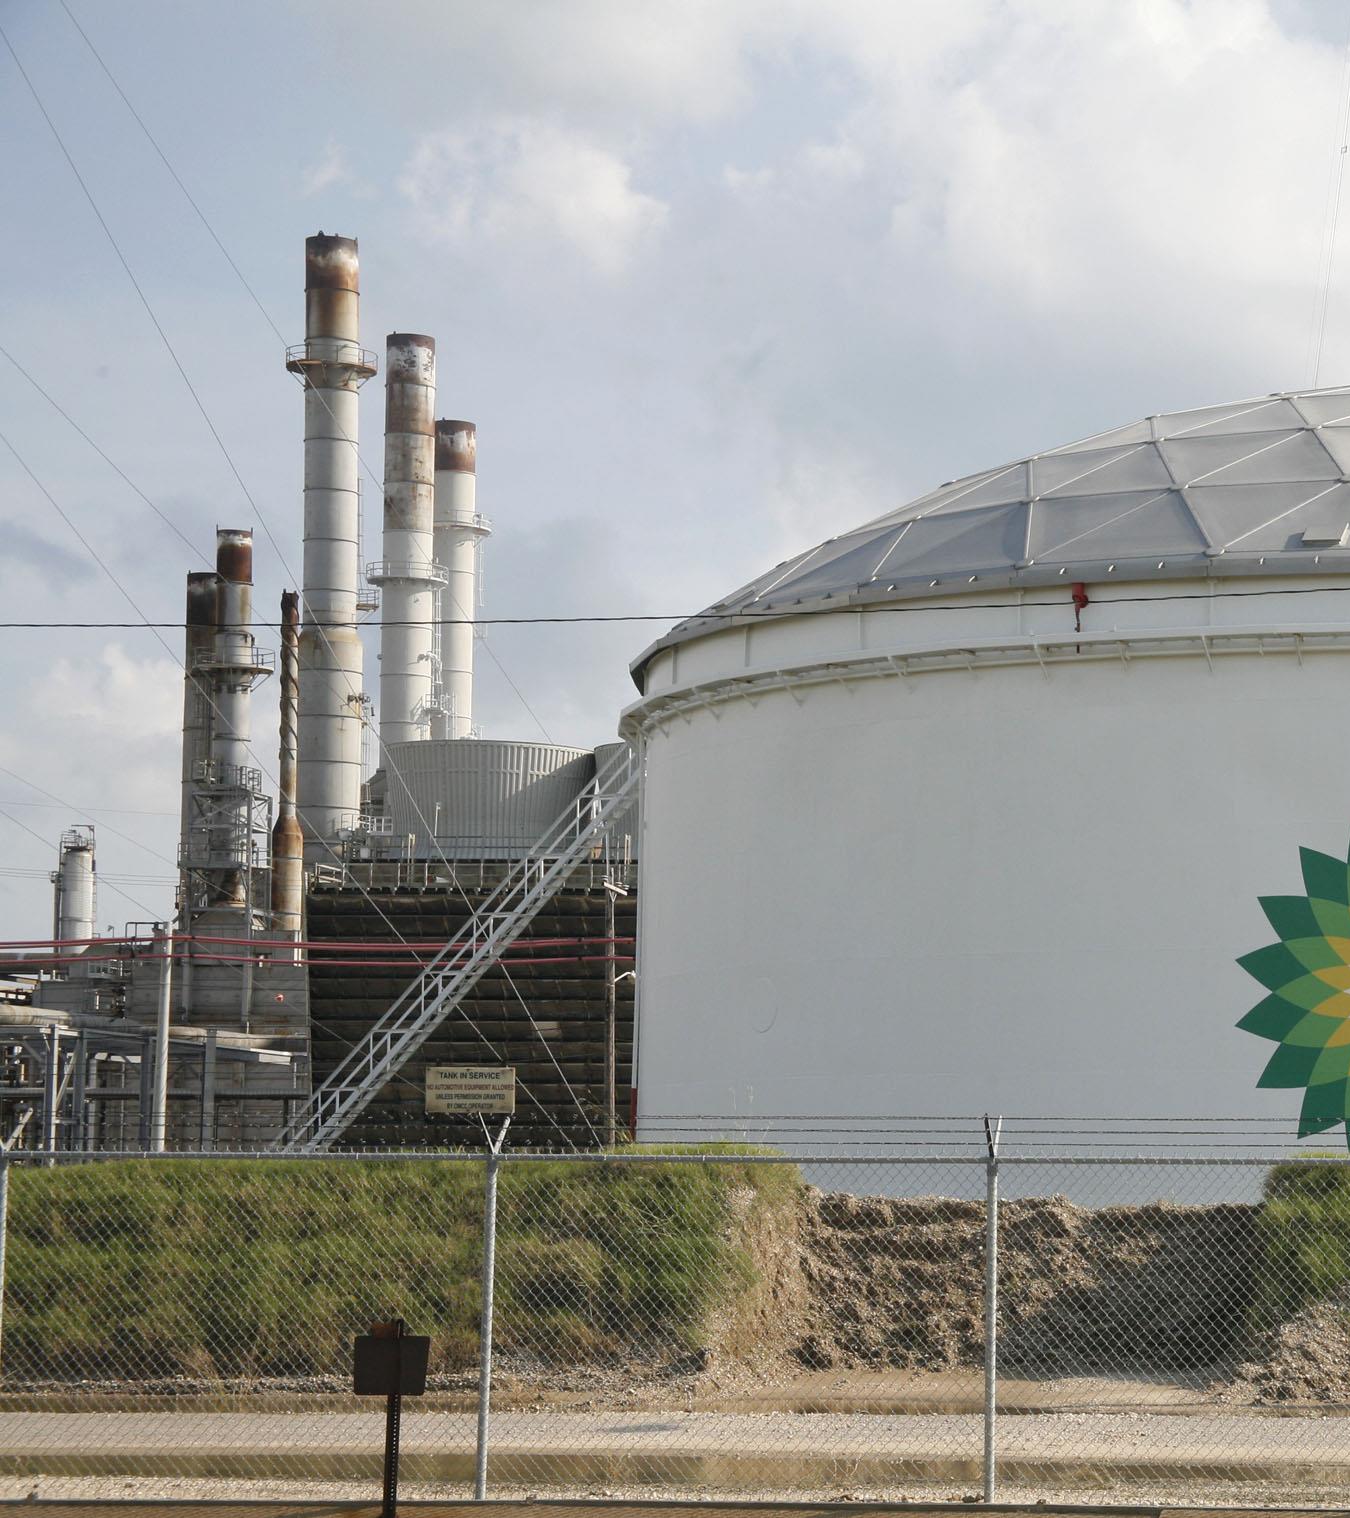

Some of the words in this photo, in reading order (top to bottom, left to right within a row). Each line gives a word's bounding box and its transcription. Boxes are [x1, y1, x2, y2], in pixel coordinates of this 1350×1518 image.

[440, 1072, 458, 1080] TANK
[460, 1072, 468, 1080] IN
[470, 1072, 501, 1080] SERVICE
